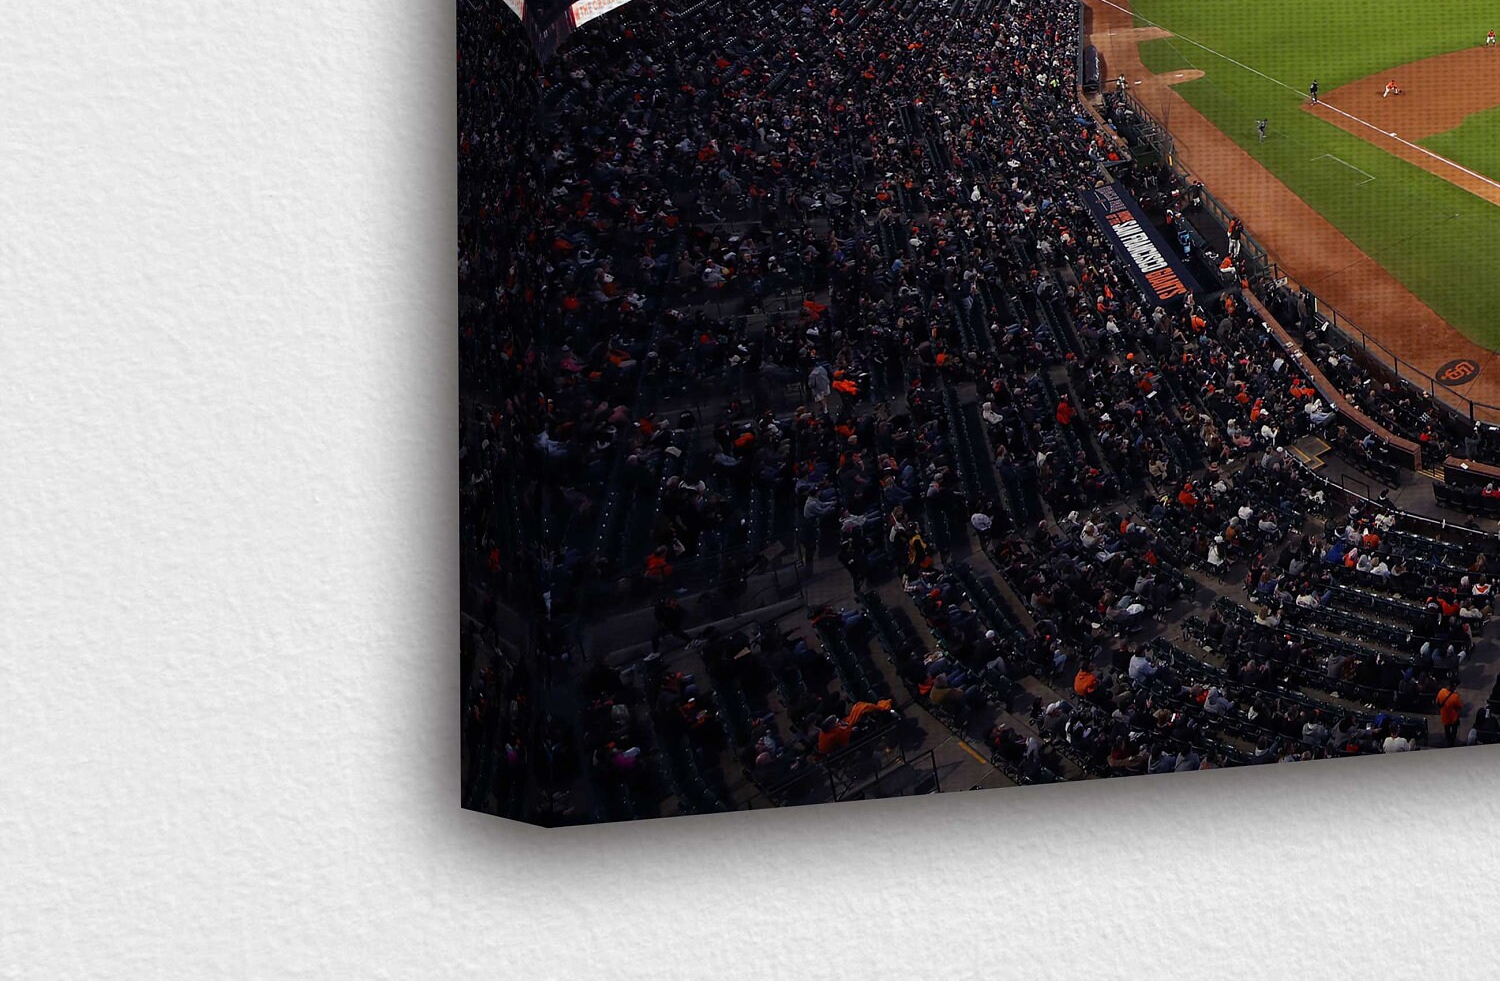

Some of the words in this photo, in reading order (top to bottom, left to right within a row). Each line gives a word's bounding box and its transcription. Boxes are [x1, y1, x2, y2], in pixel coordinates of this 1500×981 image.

[1112, 219, 1143, 241] SAN
[1122, 231, 1169, 273] FRANCISCO
[1145, 266, 1188, 300] GIANTS
